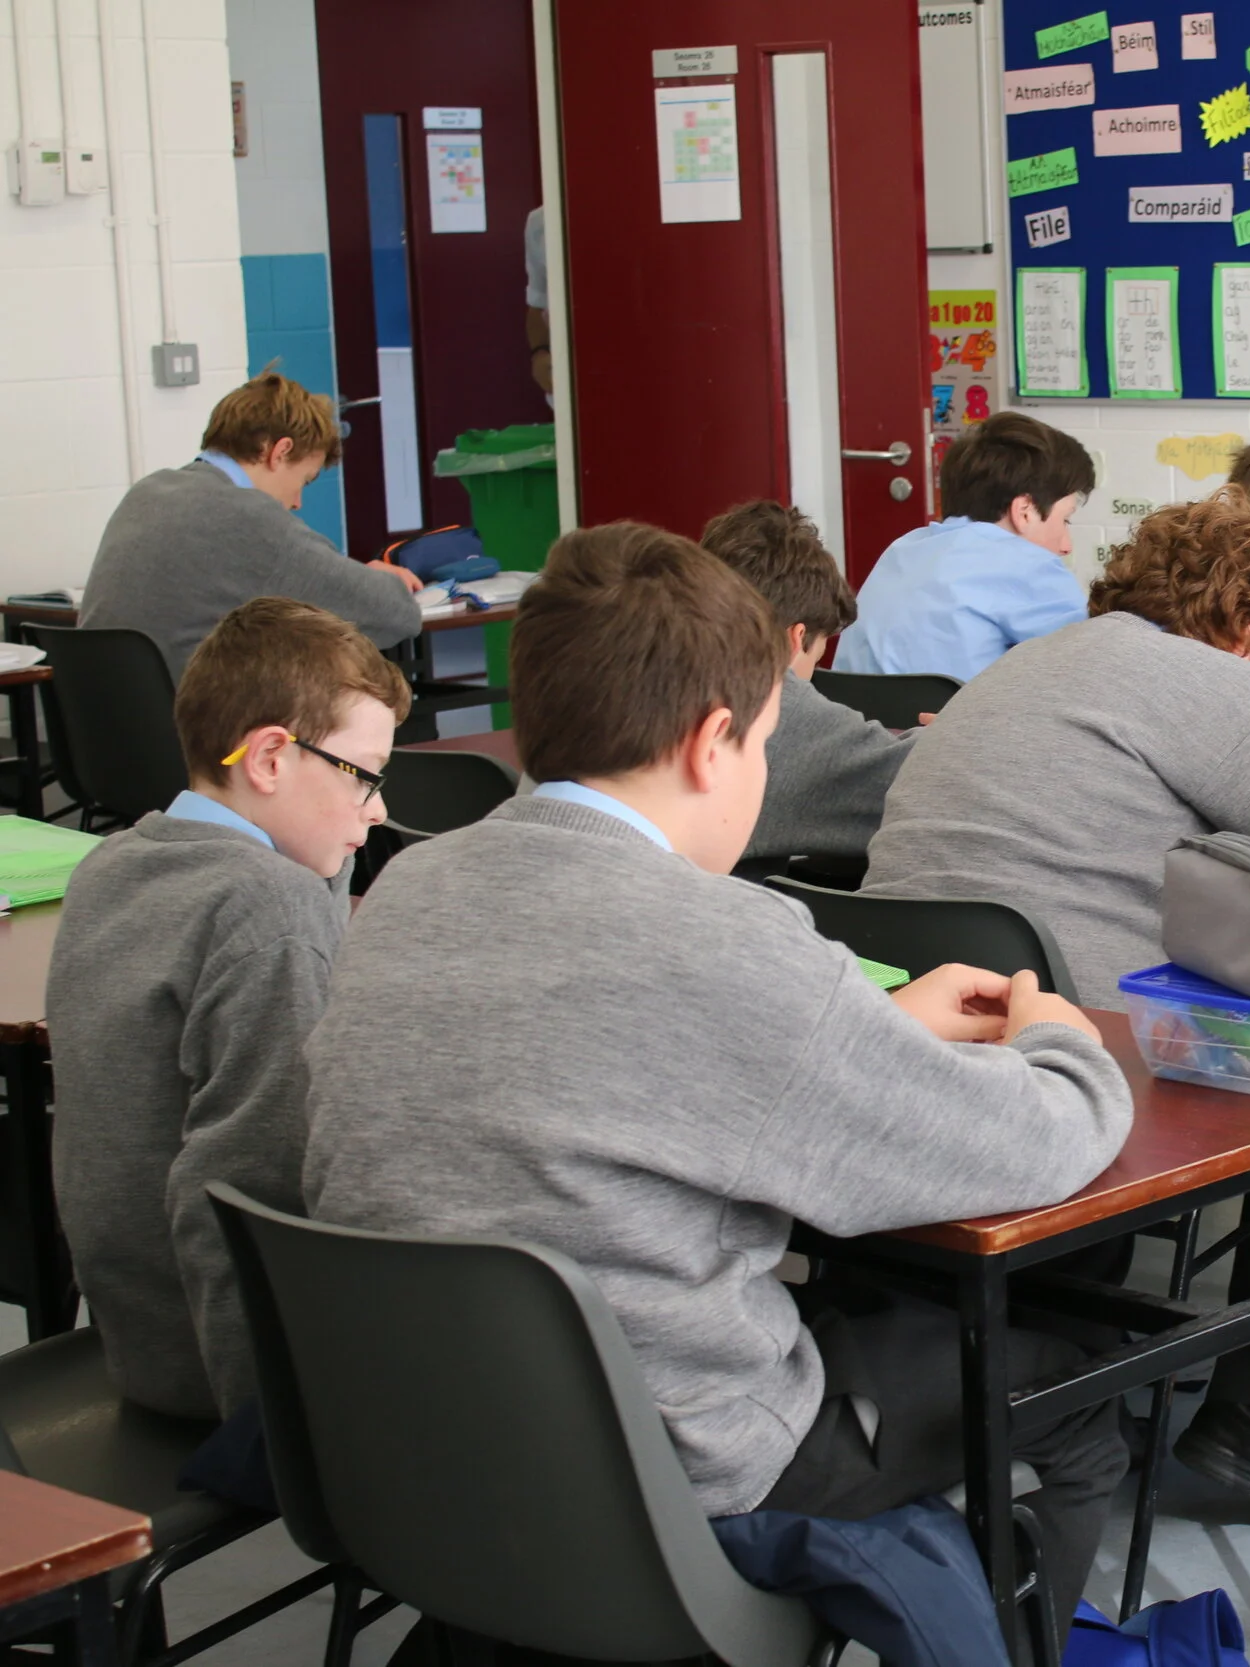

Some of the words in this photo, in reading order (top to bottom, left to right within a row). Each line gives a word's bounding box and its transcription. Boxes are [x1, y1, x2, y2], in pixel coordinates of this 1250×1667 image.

[917, 11, 973, 27] utcomes
[1119, 33, 1154, 50] Béim
[1014, 80, 1091, 101] Atmaisféar
[1108, 116, 1177, 135] Achoimre
[1134, 197, 1222, 220] Comparáid
[1029, 214, 1065, 241] File
[943, 302, 949, 321] 1
[953, 304, 971, 324] go
[974, 301, 993, 322] 20
[961, 333, 986, 371] 4
[966, 385, 990, 420] 8
